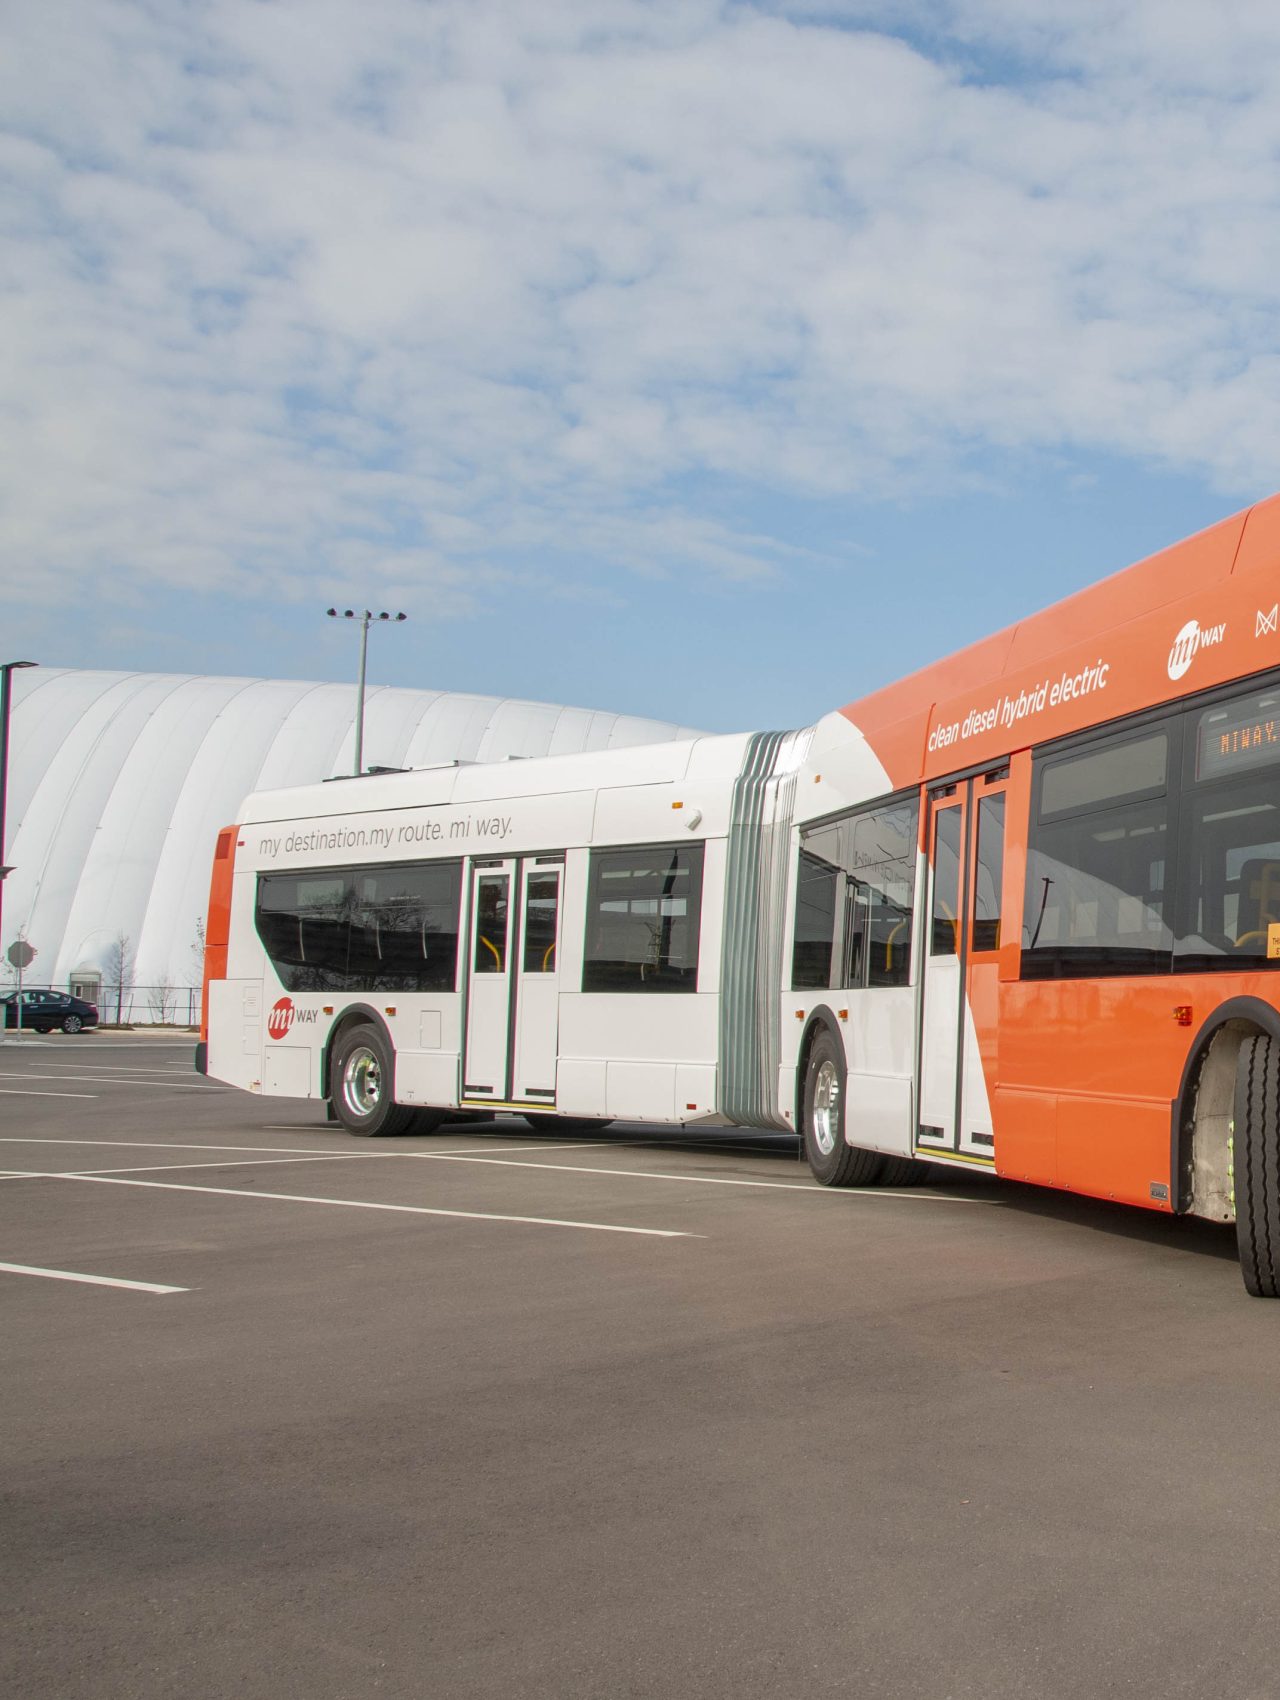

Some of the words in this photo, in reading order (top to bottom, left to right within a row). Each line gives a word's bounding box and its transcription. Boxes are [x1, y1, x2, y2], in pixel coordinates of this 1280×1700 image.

[928, 722, 960, 751] clean
[961, 698, 1001, 739] diesel
[1000, 679, 1049, 728] hybrid
[1049, 659, 1110, 706] electric
[259, 836, 281, 858] my
[398, 819, 444, 843] route.
[450, 815, 472, 839] mi
[476, 816, 513, 840] way.
